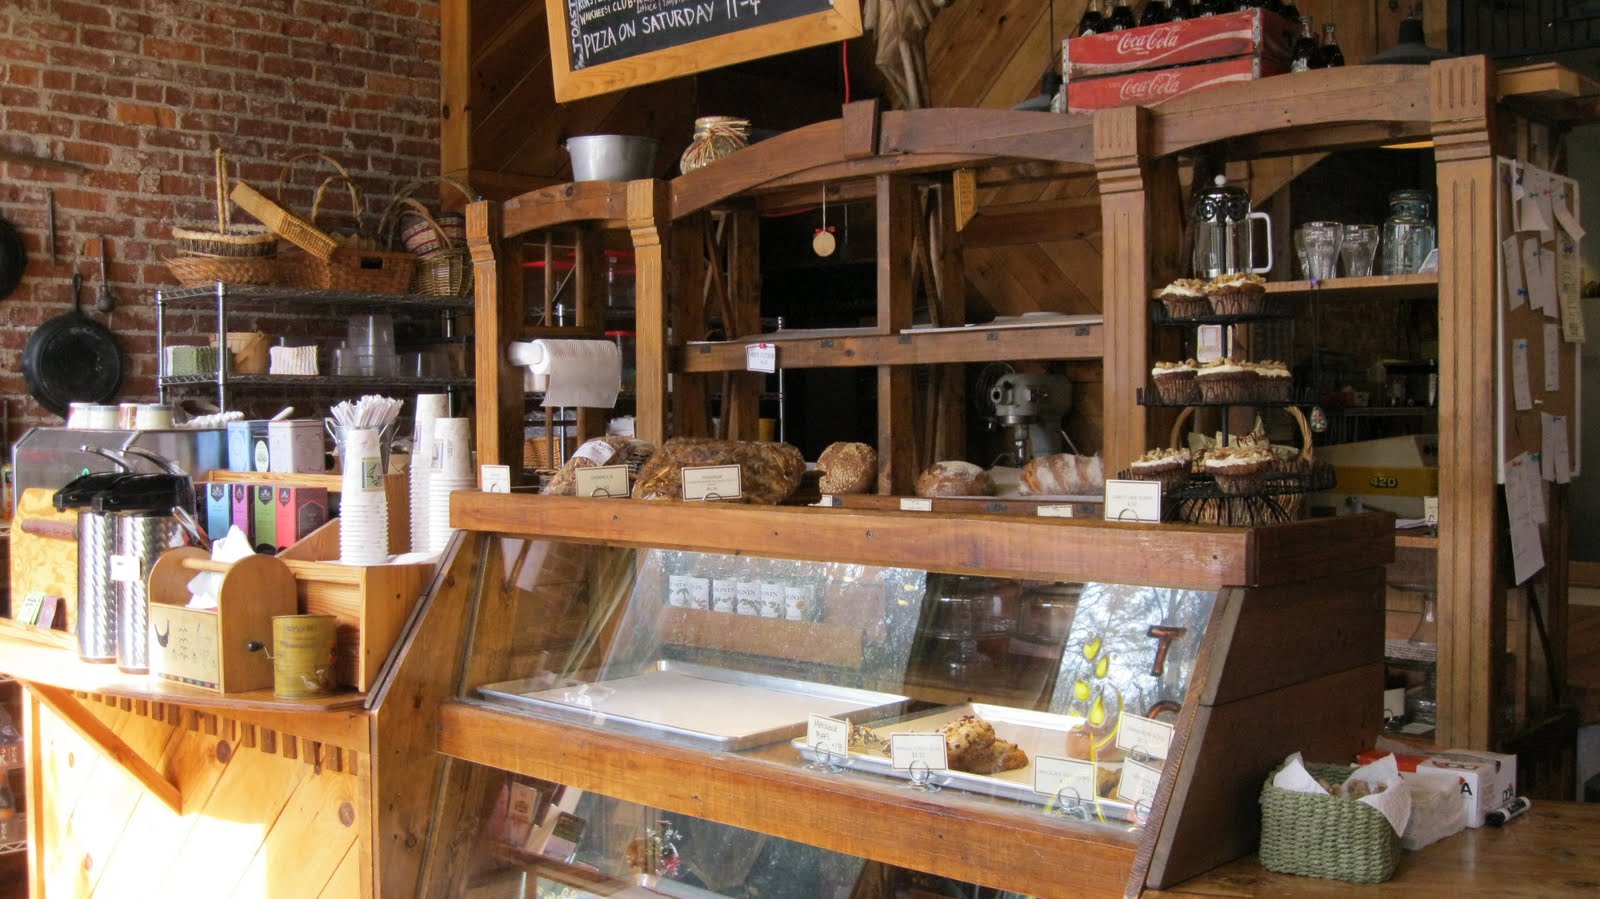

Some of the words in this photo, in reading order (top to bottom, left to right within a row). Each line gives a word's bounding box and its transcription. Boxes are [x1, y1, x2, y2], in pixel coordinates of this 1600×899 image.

[583, 26, 617, 59] PIZZA
[618, 20, 636, 42] ON
[642, 2, 714, 34] SATURDAY
[1117, 26, 1182, 54] Coca-Cola
[1120, 71, 1182, 100] Coca-Cola
[1369, 475, 1398, 489] 420
